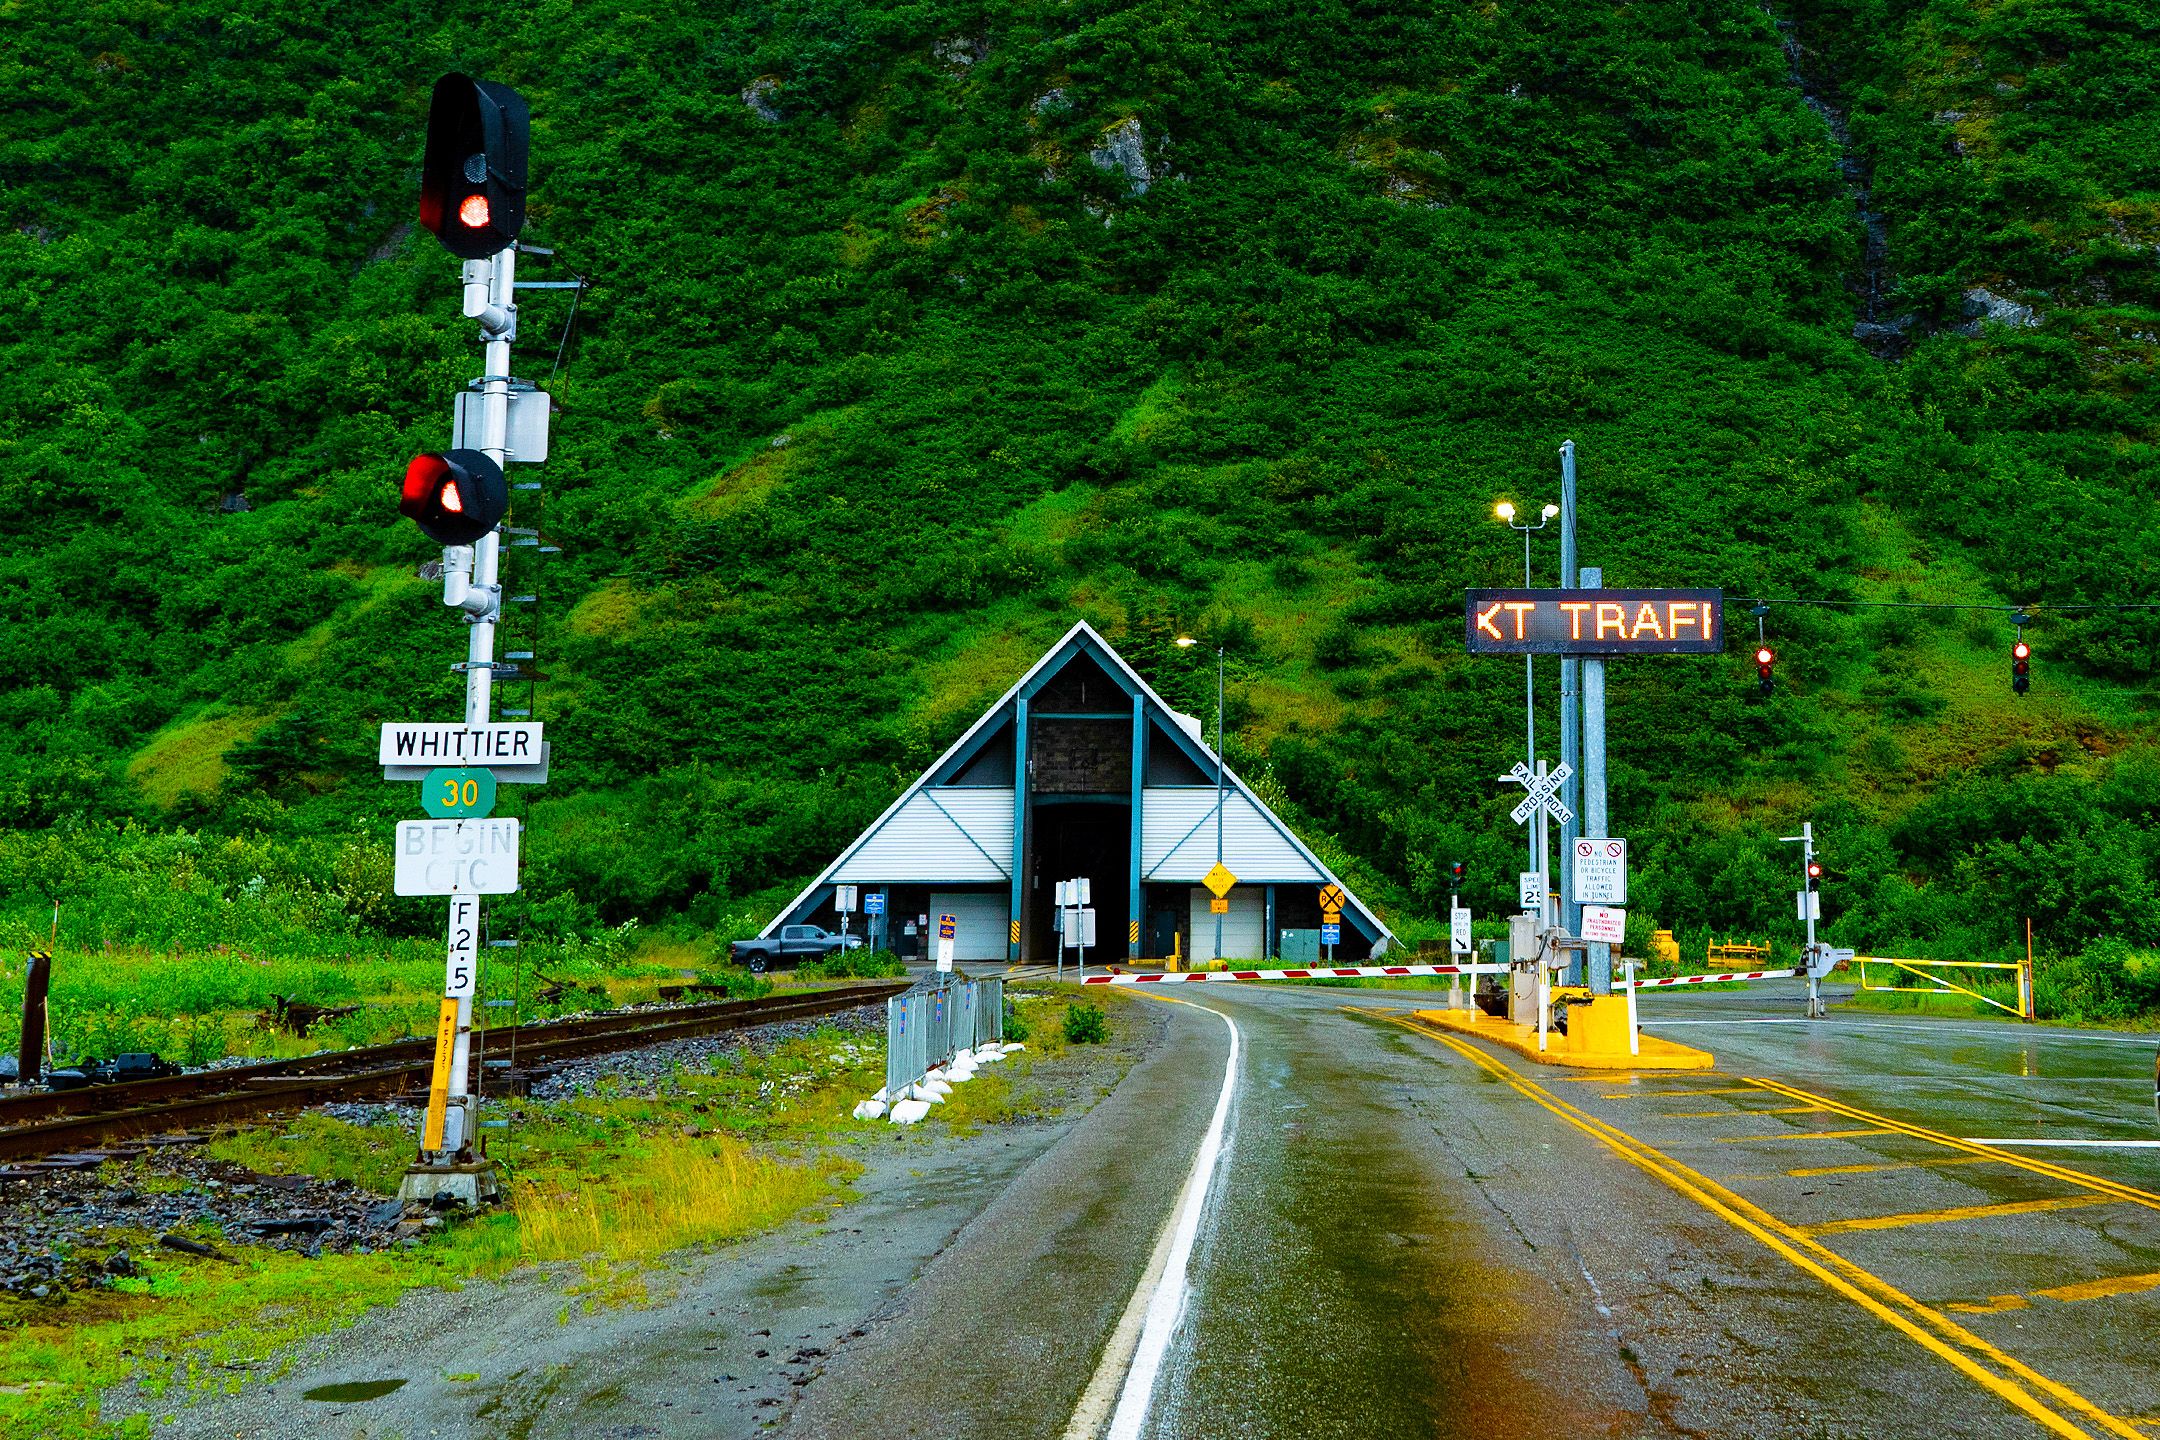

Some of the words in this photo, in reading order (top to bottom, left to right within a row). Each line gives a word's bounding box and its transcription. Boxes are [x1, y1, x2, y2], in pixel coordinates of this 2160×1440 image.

[396, 731, 529, 757] WHITTIER
[441, 779, 479, 807] 30
[1513, 764, 1536, 790] RAIL
[1544, 796, 1571, 823] ROAD
[1516, 768, 1567, 819] CROSSING
[404, 823, 511, 856] BEGIN
[425, 858, 489, 890] CTC
[1454, 912, 1468, 920] STOP
